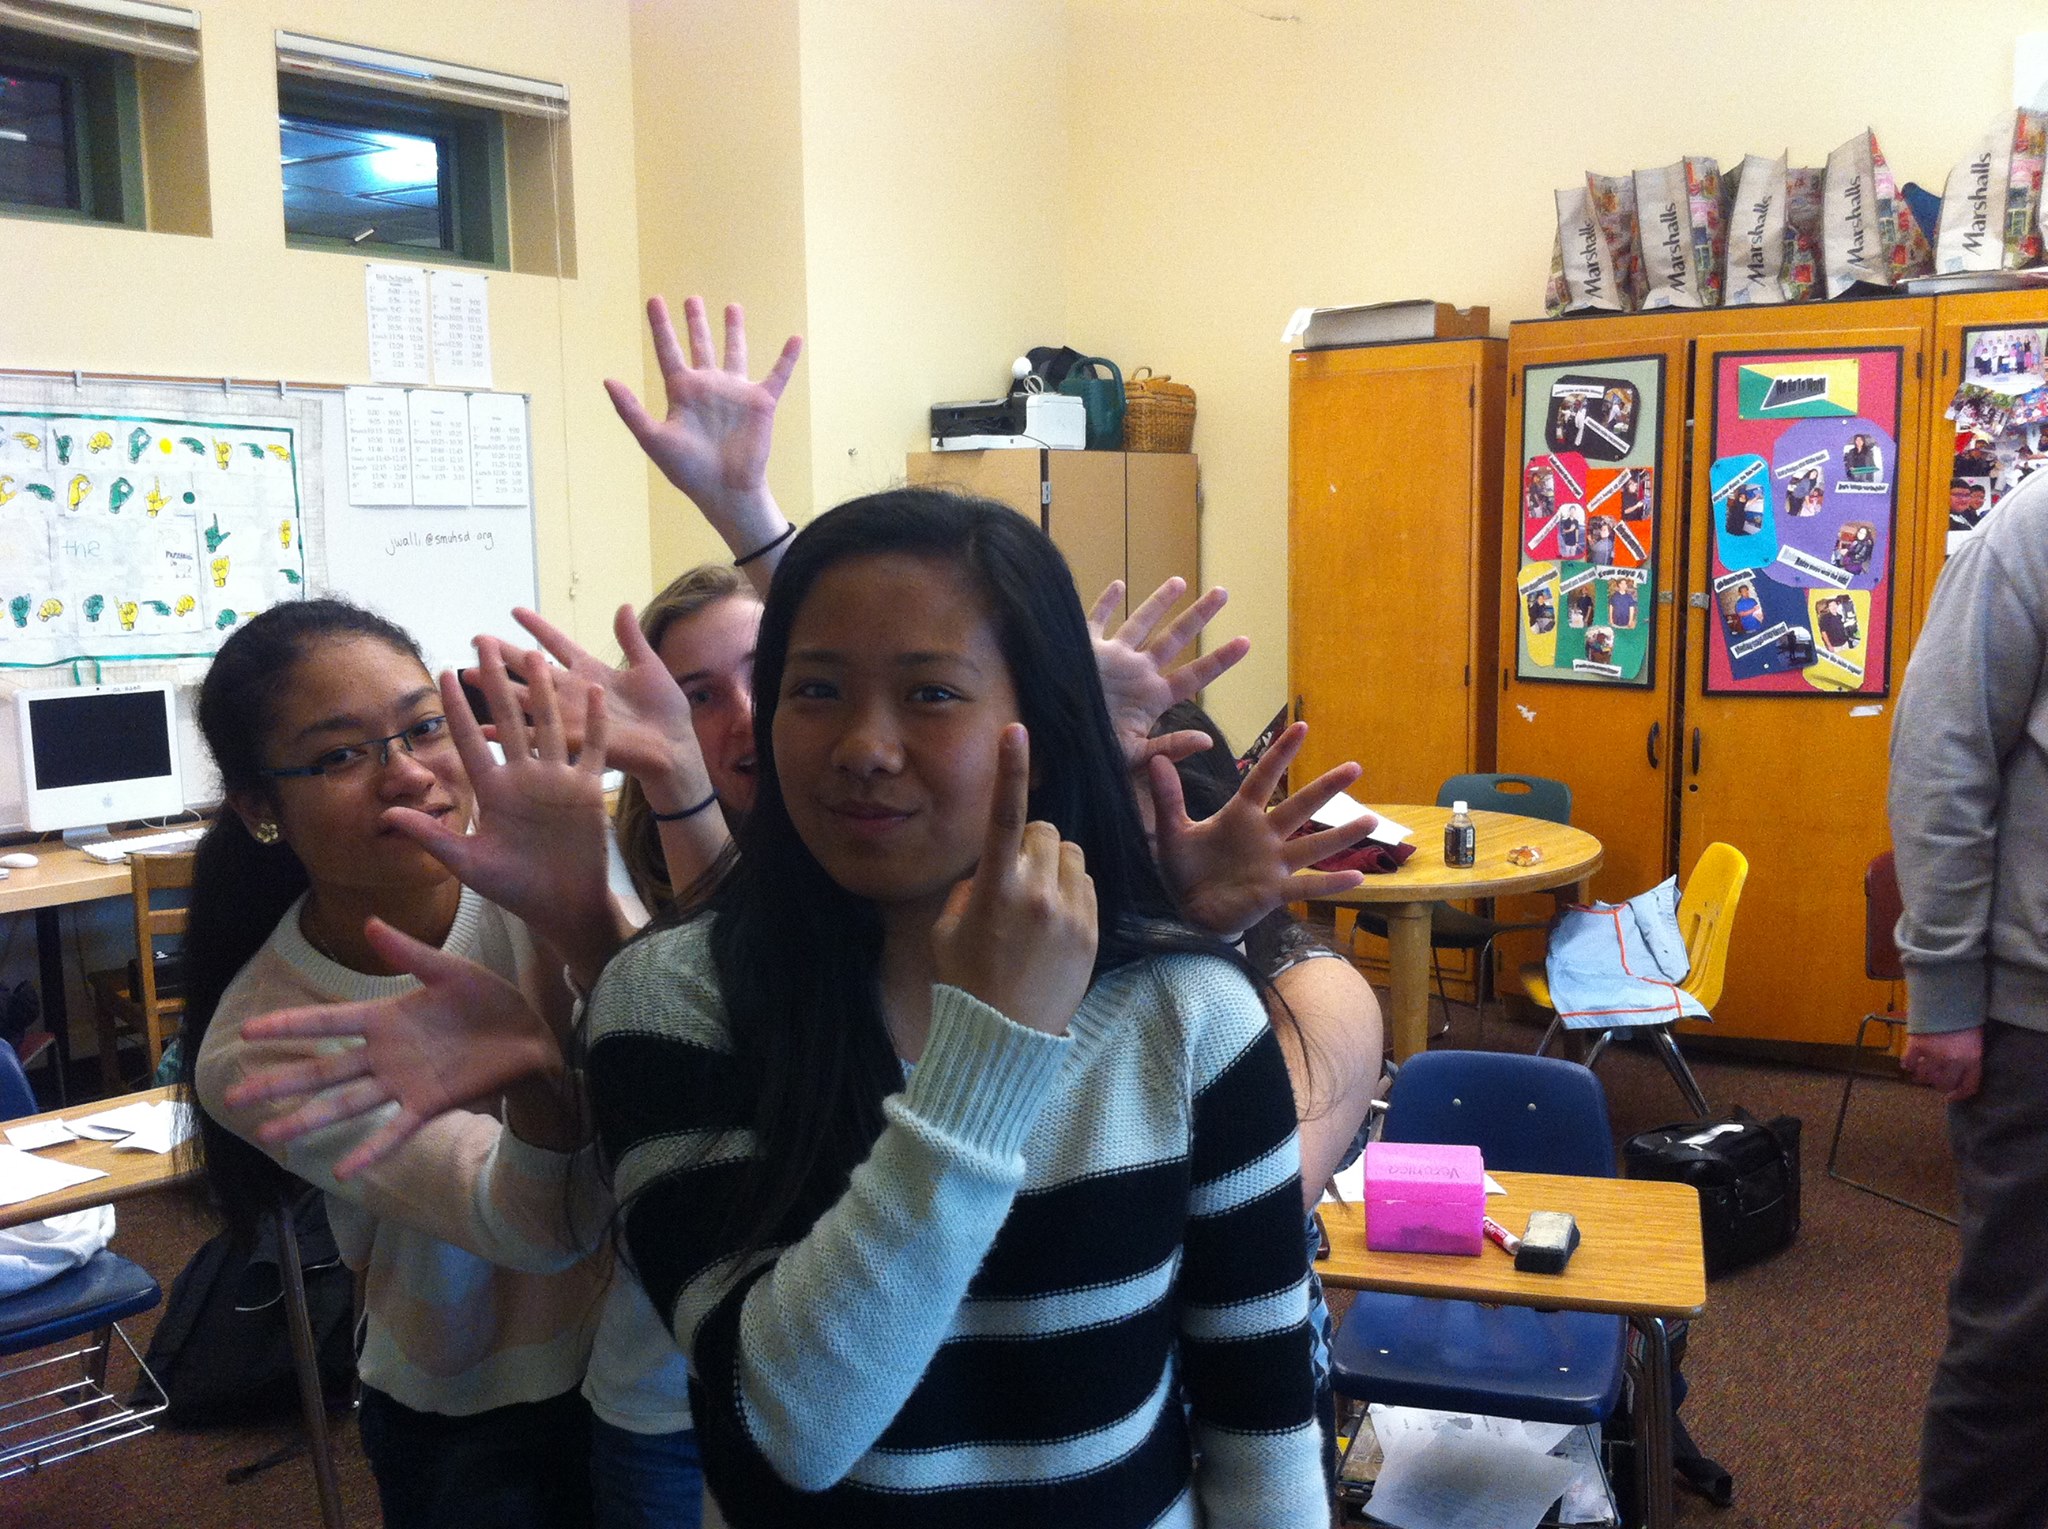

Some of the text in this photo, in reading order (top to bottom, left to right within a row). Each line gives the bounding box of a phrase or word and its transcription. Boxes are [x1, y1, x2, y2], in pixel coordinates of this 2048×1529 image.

[1660, 202, 1686, 293] Marshalls
[1747, 195, 1772, 287] Marshalls
[1844, 175, 1869, 269] Marshalls
[1962, 152, 1991, 256] Marshalls
[1579, 218, 1603, 299] Marshalls
[1388, 1166, 1460, 1179] Veronica
